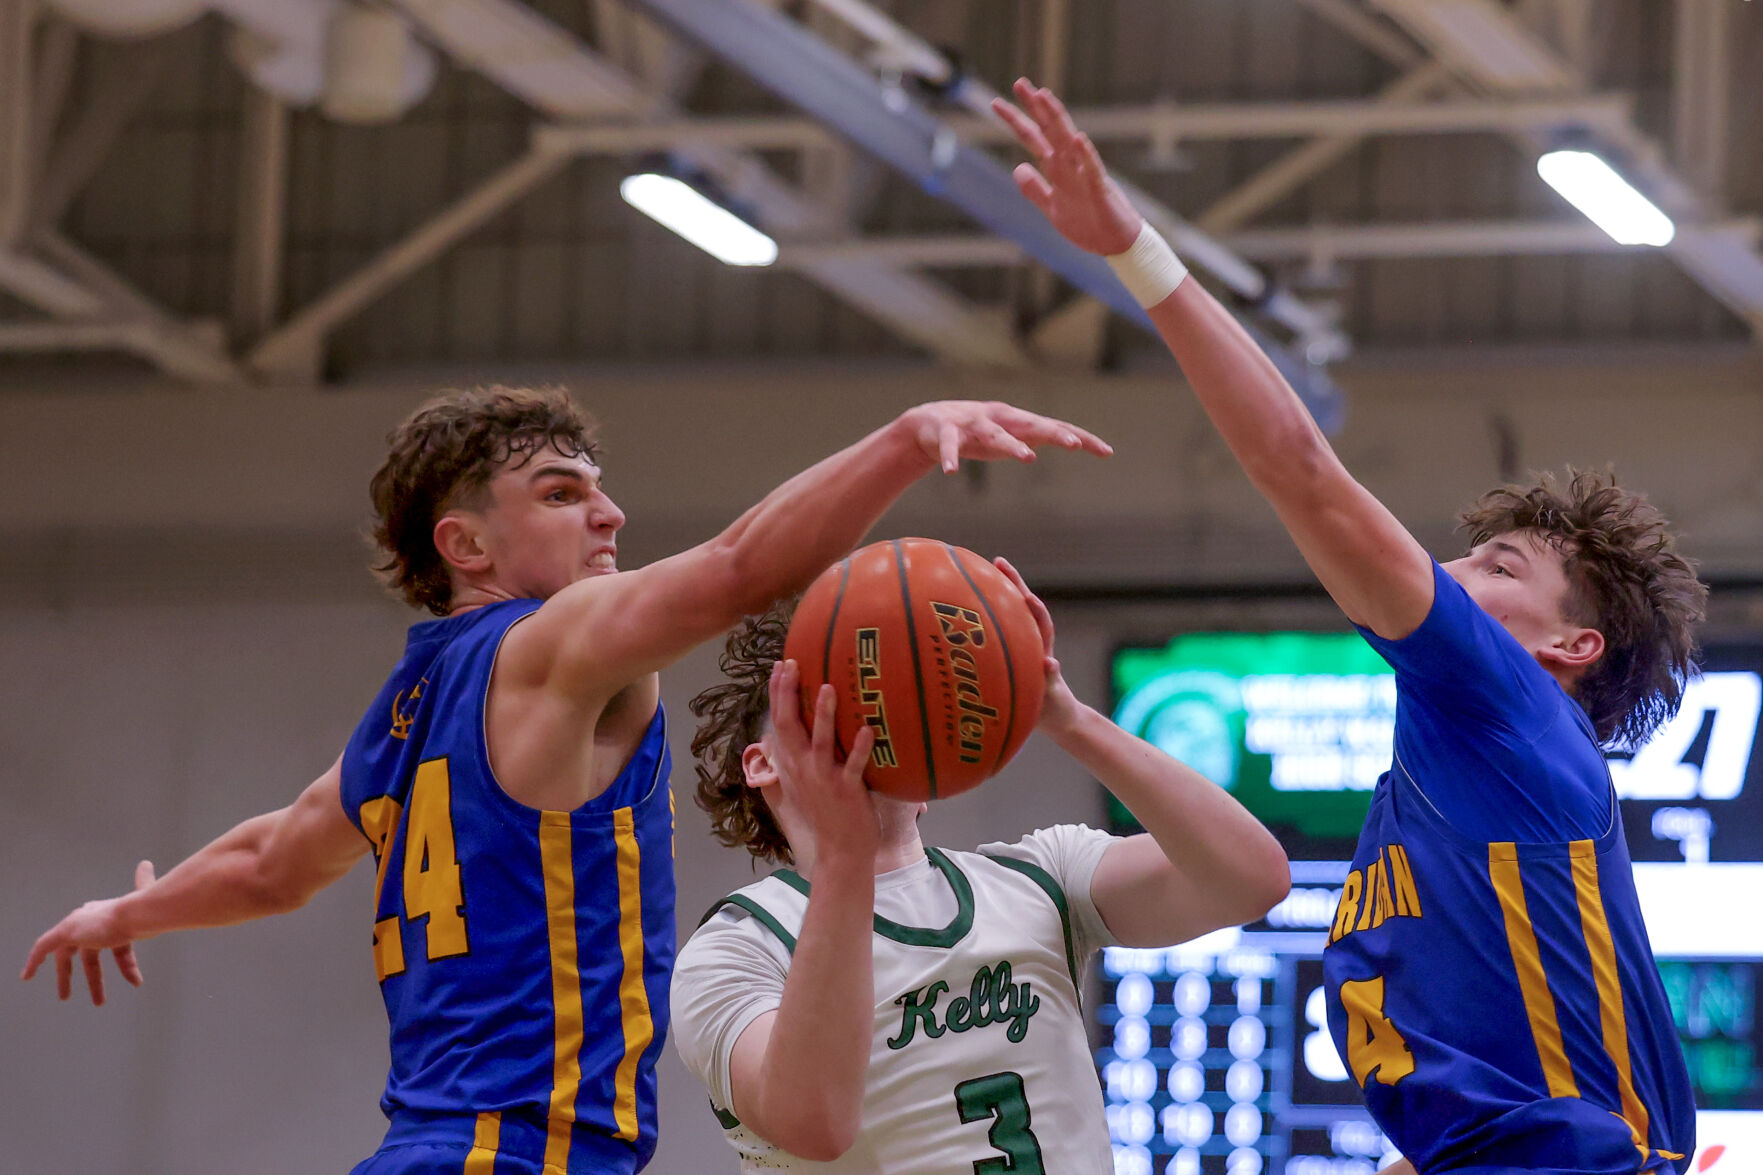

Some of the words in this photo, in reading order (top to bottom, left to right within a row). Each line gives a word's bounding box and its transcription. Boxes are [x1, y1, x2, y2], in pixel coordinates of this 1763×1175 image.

[856, 627, 898, 768] ELITE
[929, 601, 999, 764] Baden
[929, 634, 954, 746] PERFECTION
[887, 960, 1040, 1050] Kelly
[1340, 975, 1416, 1090] 4
[954, 1071, 1046, 1175] 3
